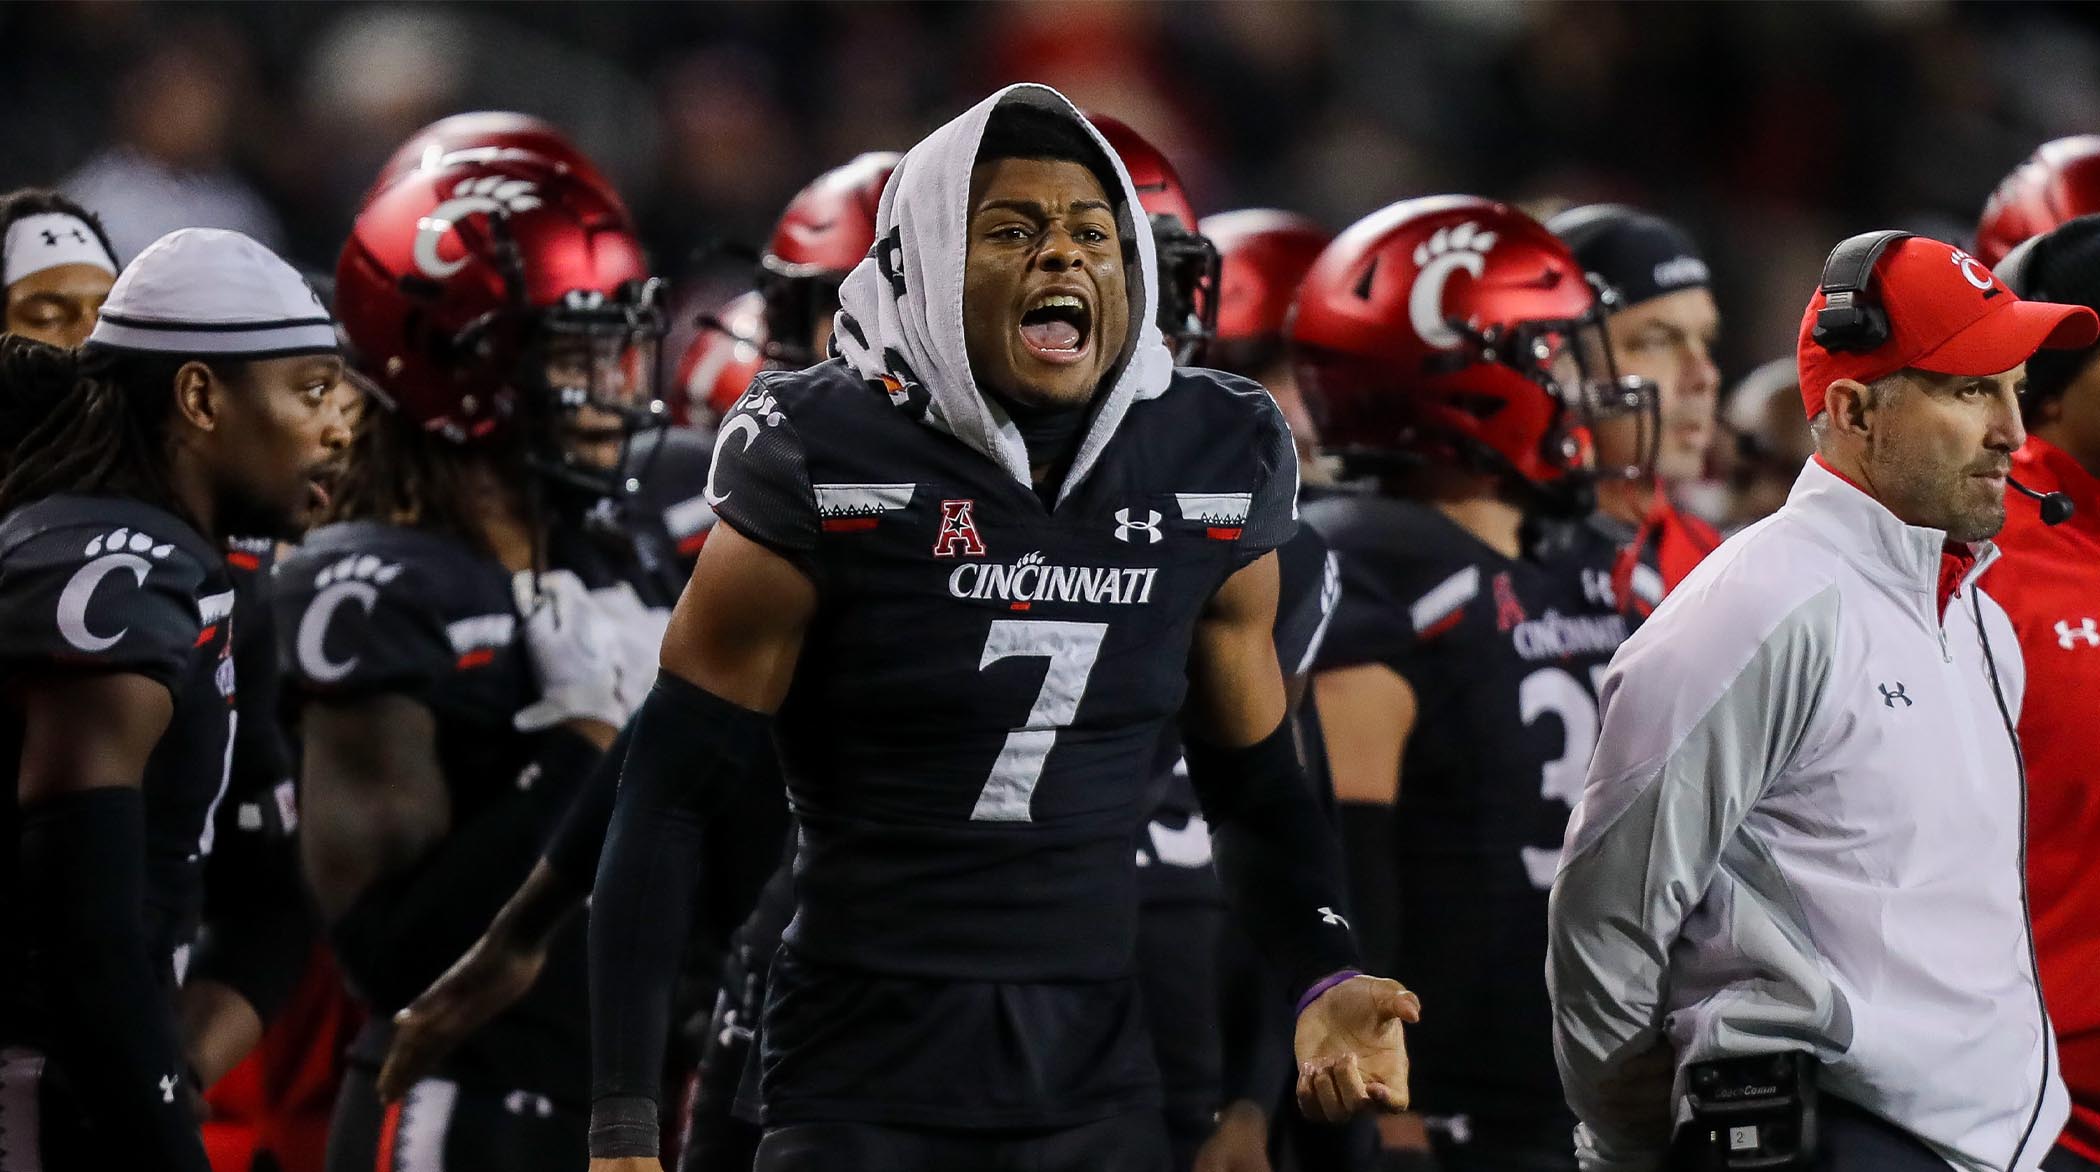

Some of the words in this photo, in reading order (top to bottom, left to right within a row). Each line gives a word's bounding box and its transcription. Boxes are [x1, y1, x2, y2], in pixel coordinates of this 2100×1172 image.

[933, 500, 987, 558] A
[949, 562, 1159, 604] CINCINNATI
[969, 619, 1109, 823] 7
[1736, 1131, 1744, 1144] 2
